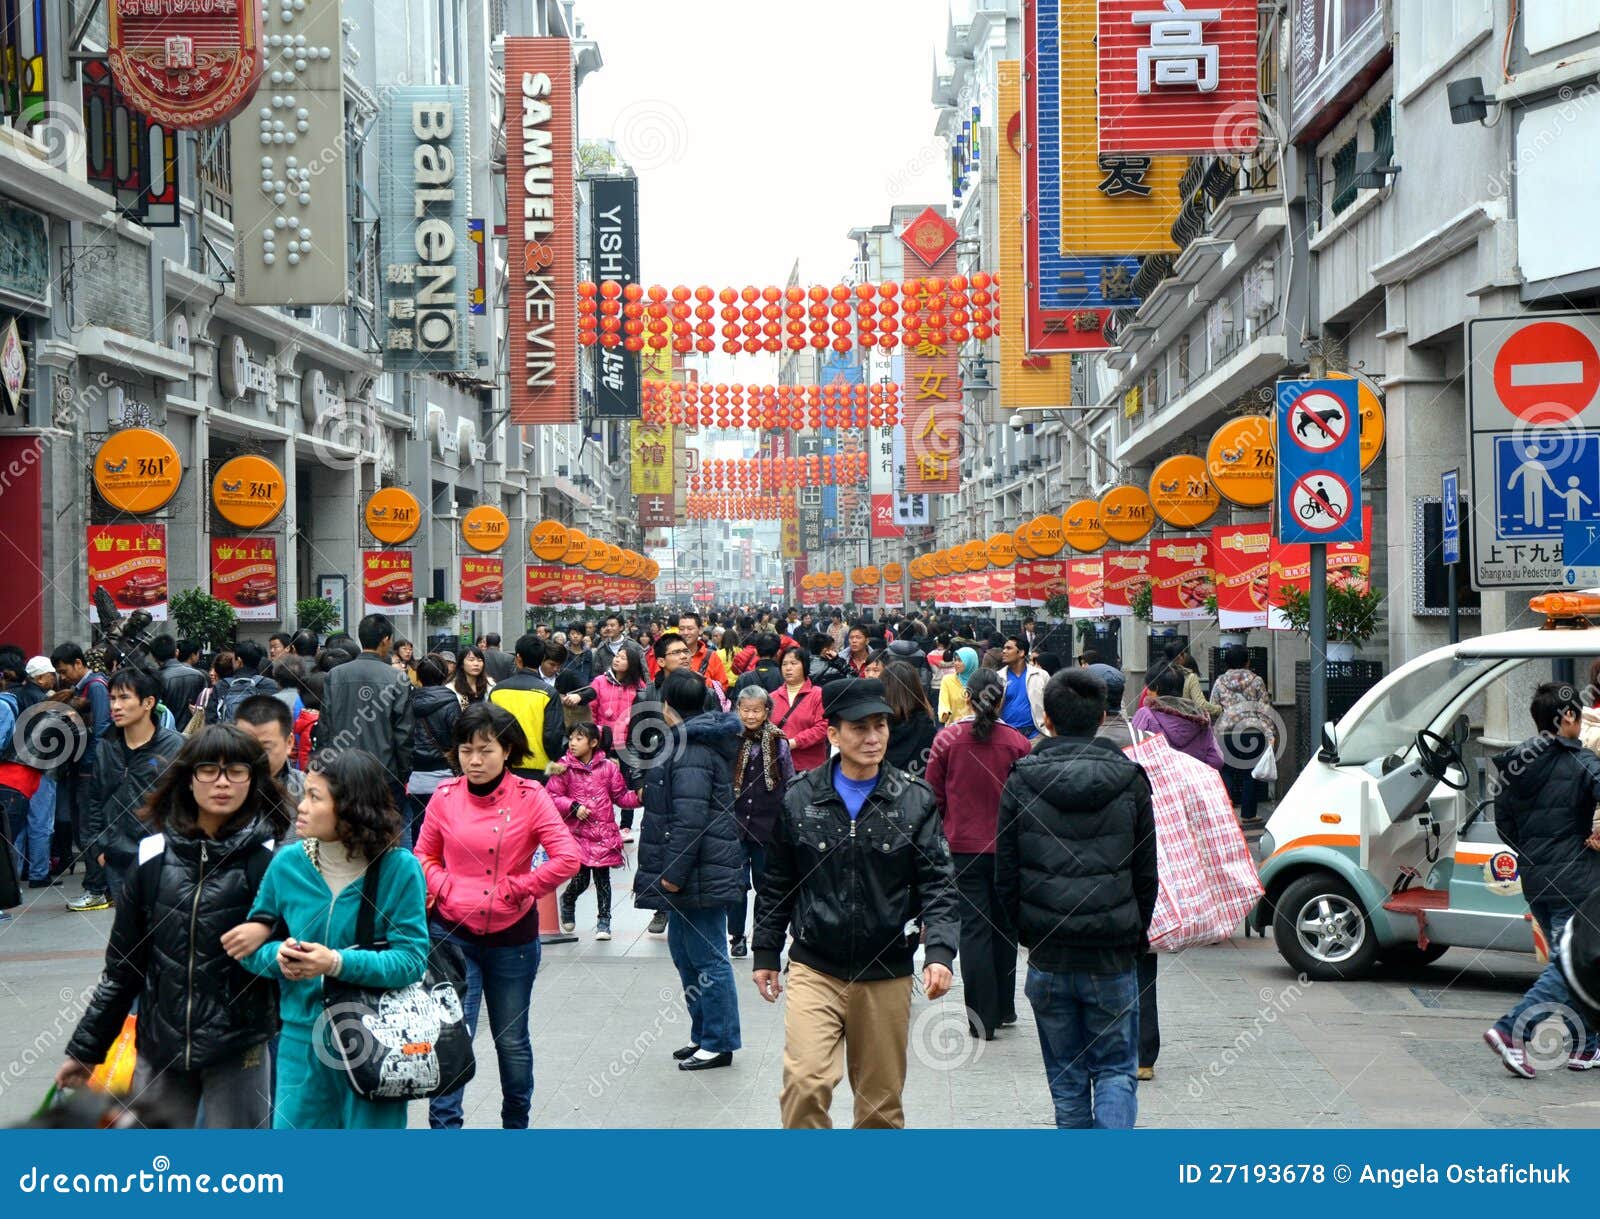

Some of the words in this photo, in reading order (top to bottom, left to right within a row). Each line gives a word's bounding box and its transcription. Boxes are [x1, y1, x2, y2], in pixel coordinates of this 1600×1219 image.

[1131, 0, 1222, 95] 高
[600, 205, 630, 320] YISHi
[1254, 449, 1275, 467] 36
[1186, 481, 1209, 496] 361
